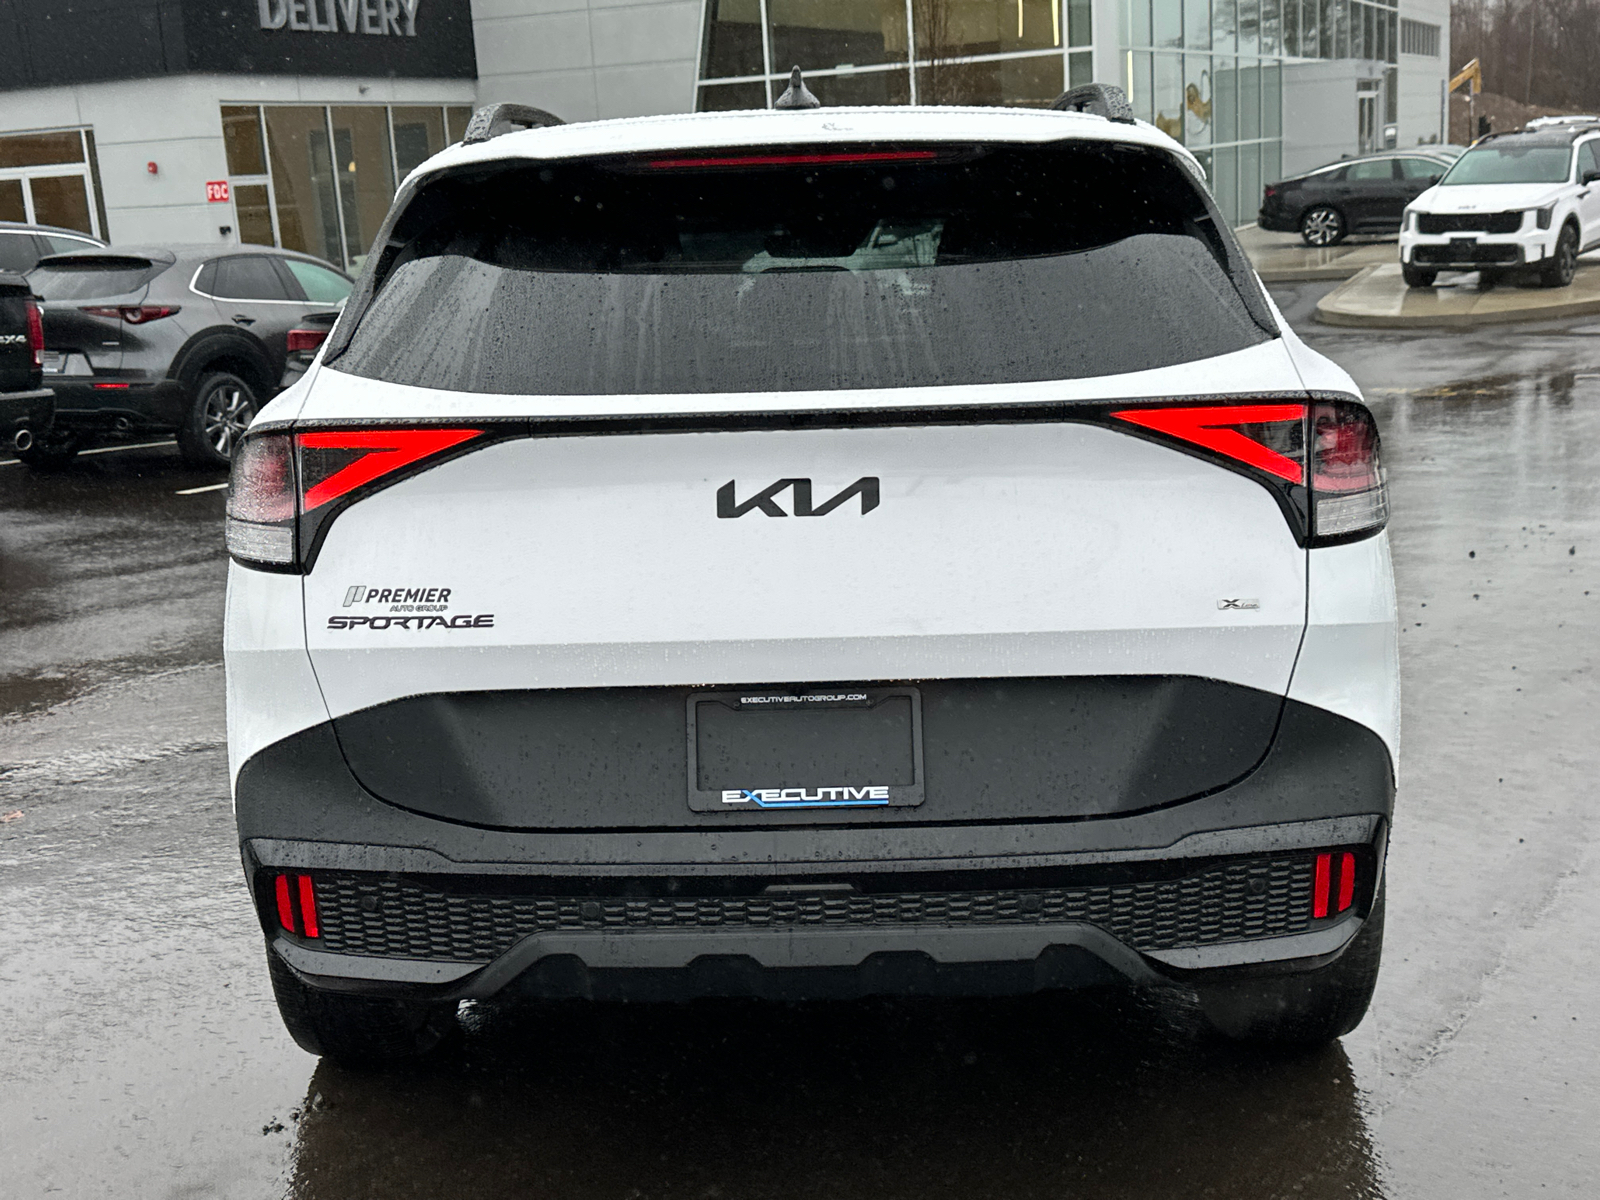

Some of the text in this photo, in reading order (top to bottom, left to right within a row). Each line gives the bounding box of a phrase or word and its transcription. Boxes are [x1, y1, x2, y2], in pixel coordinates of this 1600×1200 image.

[258, 0, 419, 37] DELIVERY
[716, 476, 880, 519] KIA
[364, 588, 452, 603] PREMIER
[389, 604, 449, 612] AUTO GROUP
[327, 614, 495, 630] SPORTAGE
[740, 694, 867, 704] EXECUTIVEAUTOGROUP.COM
[721, 786, 889, 806] EXECUTIVE
